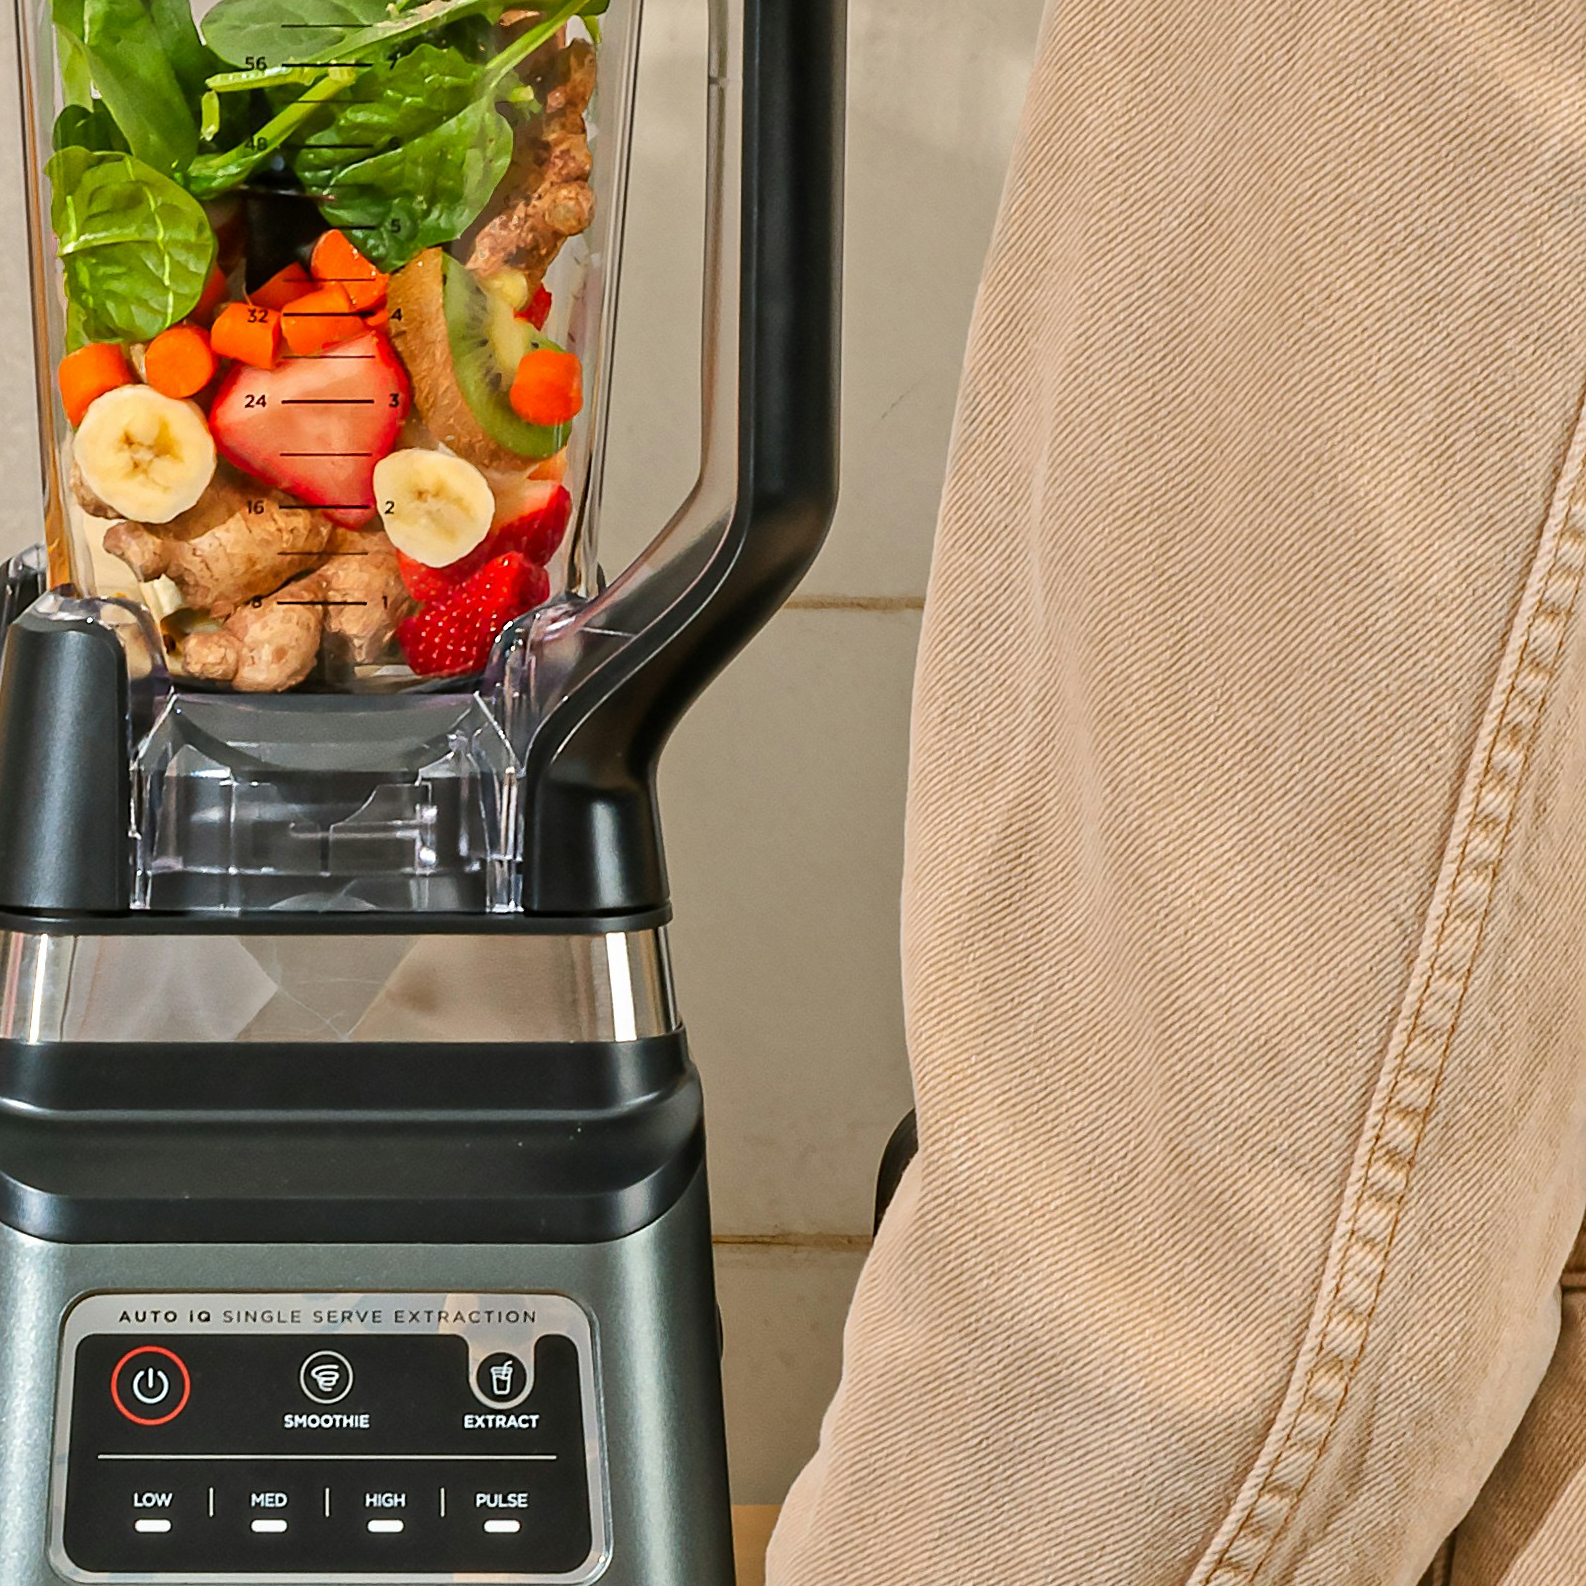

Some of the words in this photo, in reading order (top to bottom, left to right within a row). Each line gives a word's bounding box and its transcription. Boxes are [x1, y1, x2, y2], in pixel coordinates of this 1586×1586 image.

[245, 56, 267, 71] 56
[390, 219, 401, 233] 5
[247, 309, 268, 323] 32
[391, 308, 402, 322] 4
[244, 394, 267, 408] 24
[389, 393, 399, 408] 3
[247, 500, 265, 514] 16
[385, 501, 395, 514] 2
[382, 595, 388, 609] 1
[119, 1310, 177, 1323] AUTO
[222, 1310, 301, 1323] SINGLE
[313, 1310, 382, 1323] SERVE
[394, 1310, 536, 1323] EXTRACTION
[284, 1415, 370, 1428] SMOOTHIE
[464, 1415, 539, 1428] EXTRACT
[134, 1492, 172, 1507] LOW
[251, 1492, 287, 1507] MED
[365, 1493, 406, 1507] HIGH
[476, 1493, 528, 1507] PULSE
